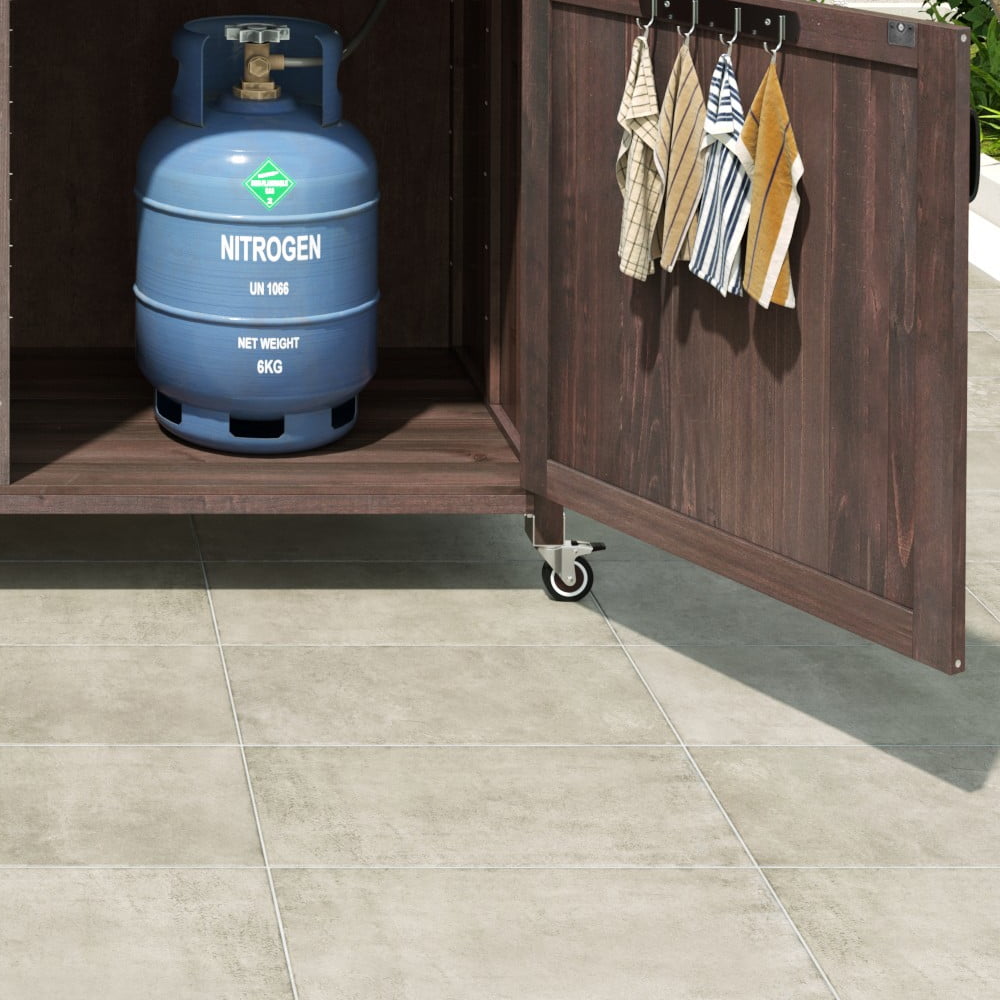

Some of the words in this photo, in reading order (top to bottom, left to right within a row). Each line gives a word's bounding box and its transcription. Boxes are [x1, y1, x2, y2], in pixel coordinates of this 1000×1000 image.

[220, 234, 322, 262] NITROGEN
[249, 281, 265, 296] UN
[267, 281, 290, 296] 1066
[237, 337, 258, 350] NET
[260, 336, 301, 350] WEIGHT
[256, 359, 284, 374] 6KG
